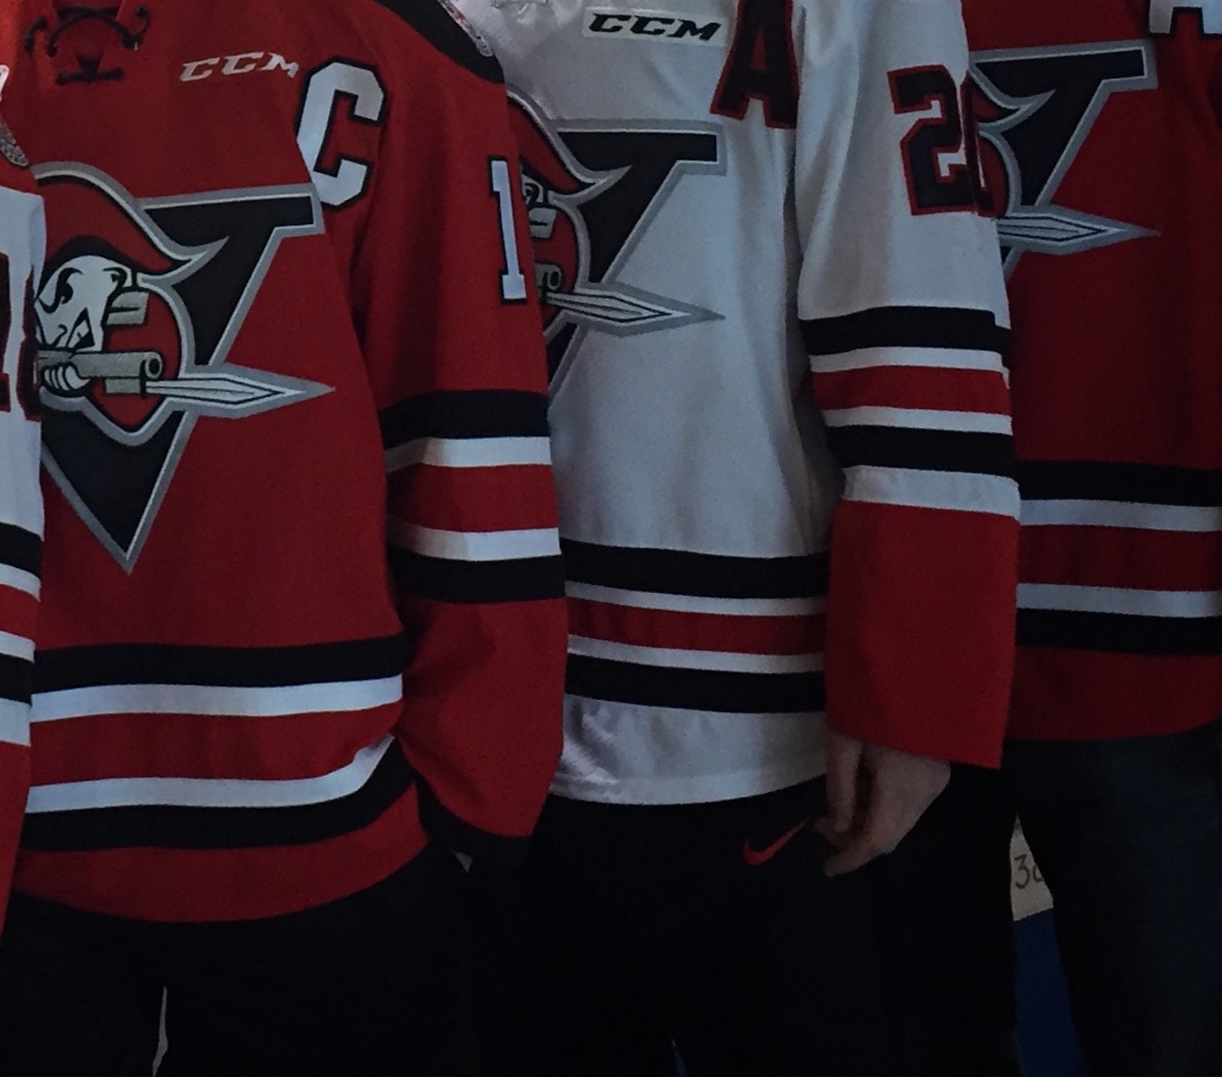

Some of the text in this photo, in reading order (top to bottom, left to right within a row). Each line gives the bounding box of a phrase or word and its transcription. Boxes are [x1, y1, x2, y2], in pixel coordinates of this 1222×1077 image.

[587, 9, 721, 42] CCM
[180, 52, 300, 82] CCM
[295, 60, 387, 209] C
